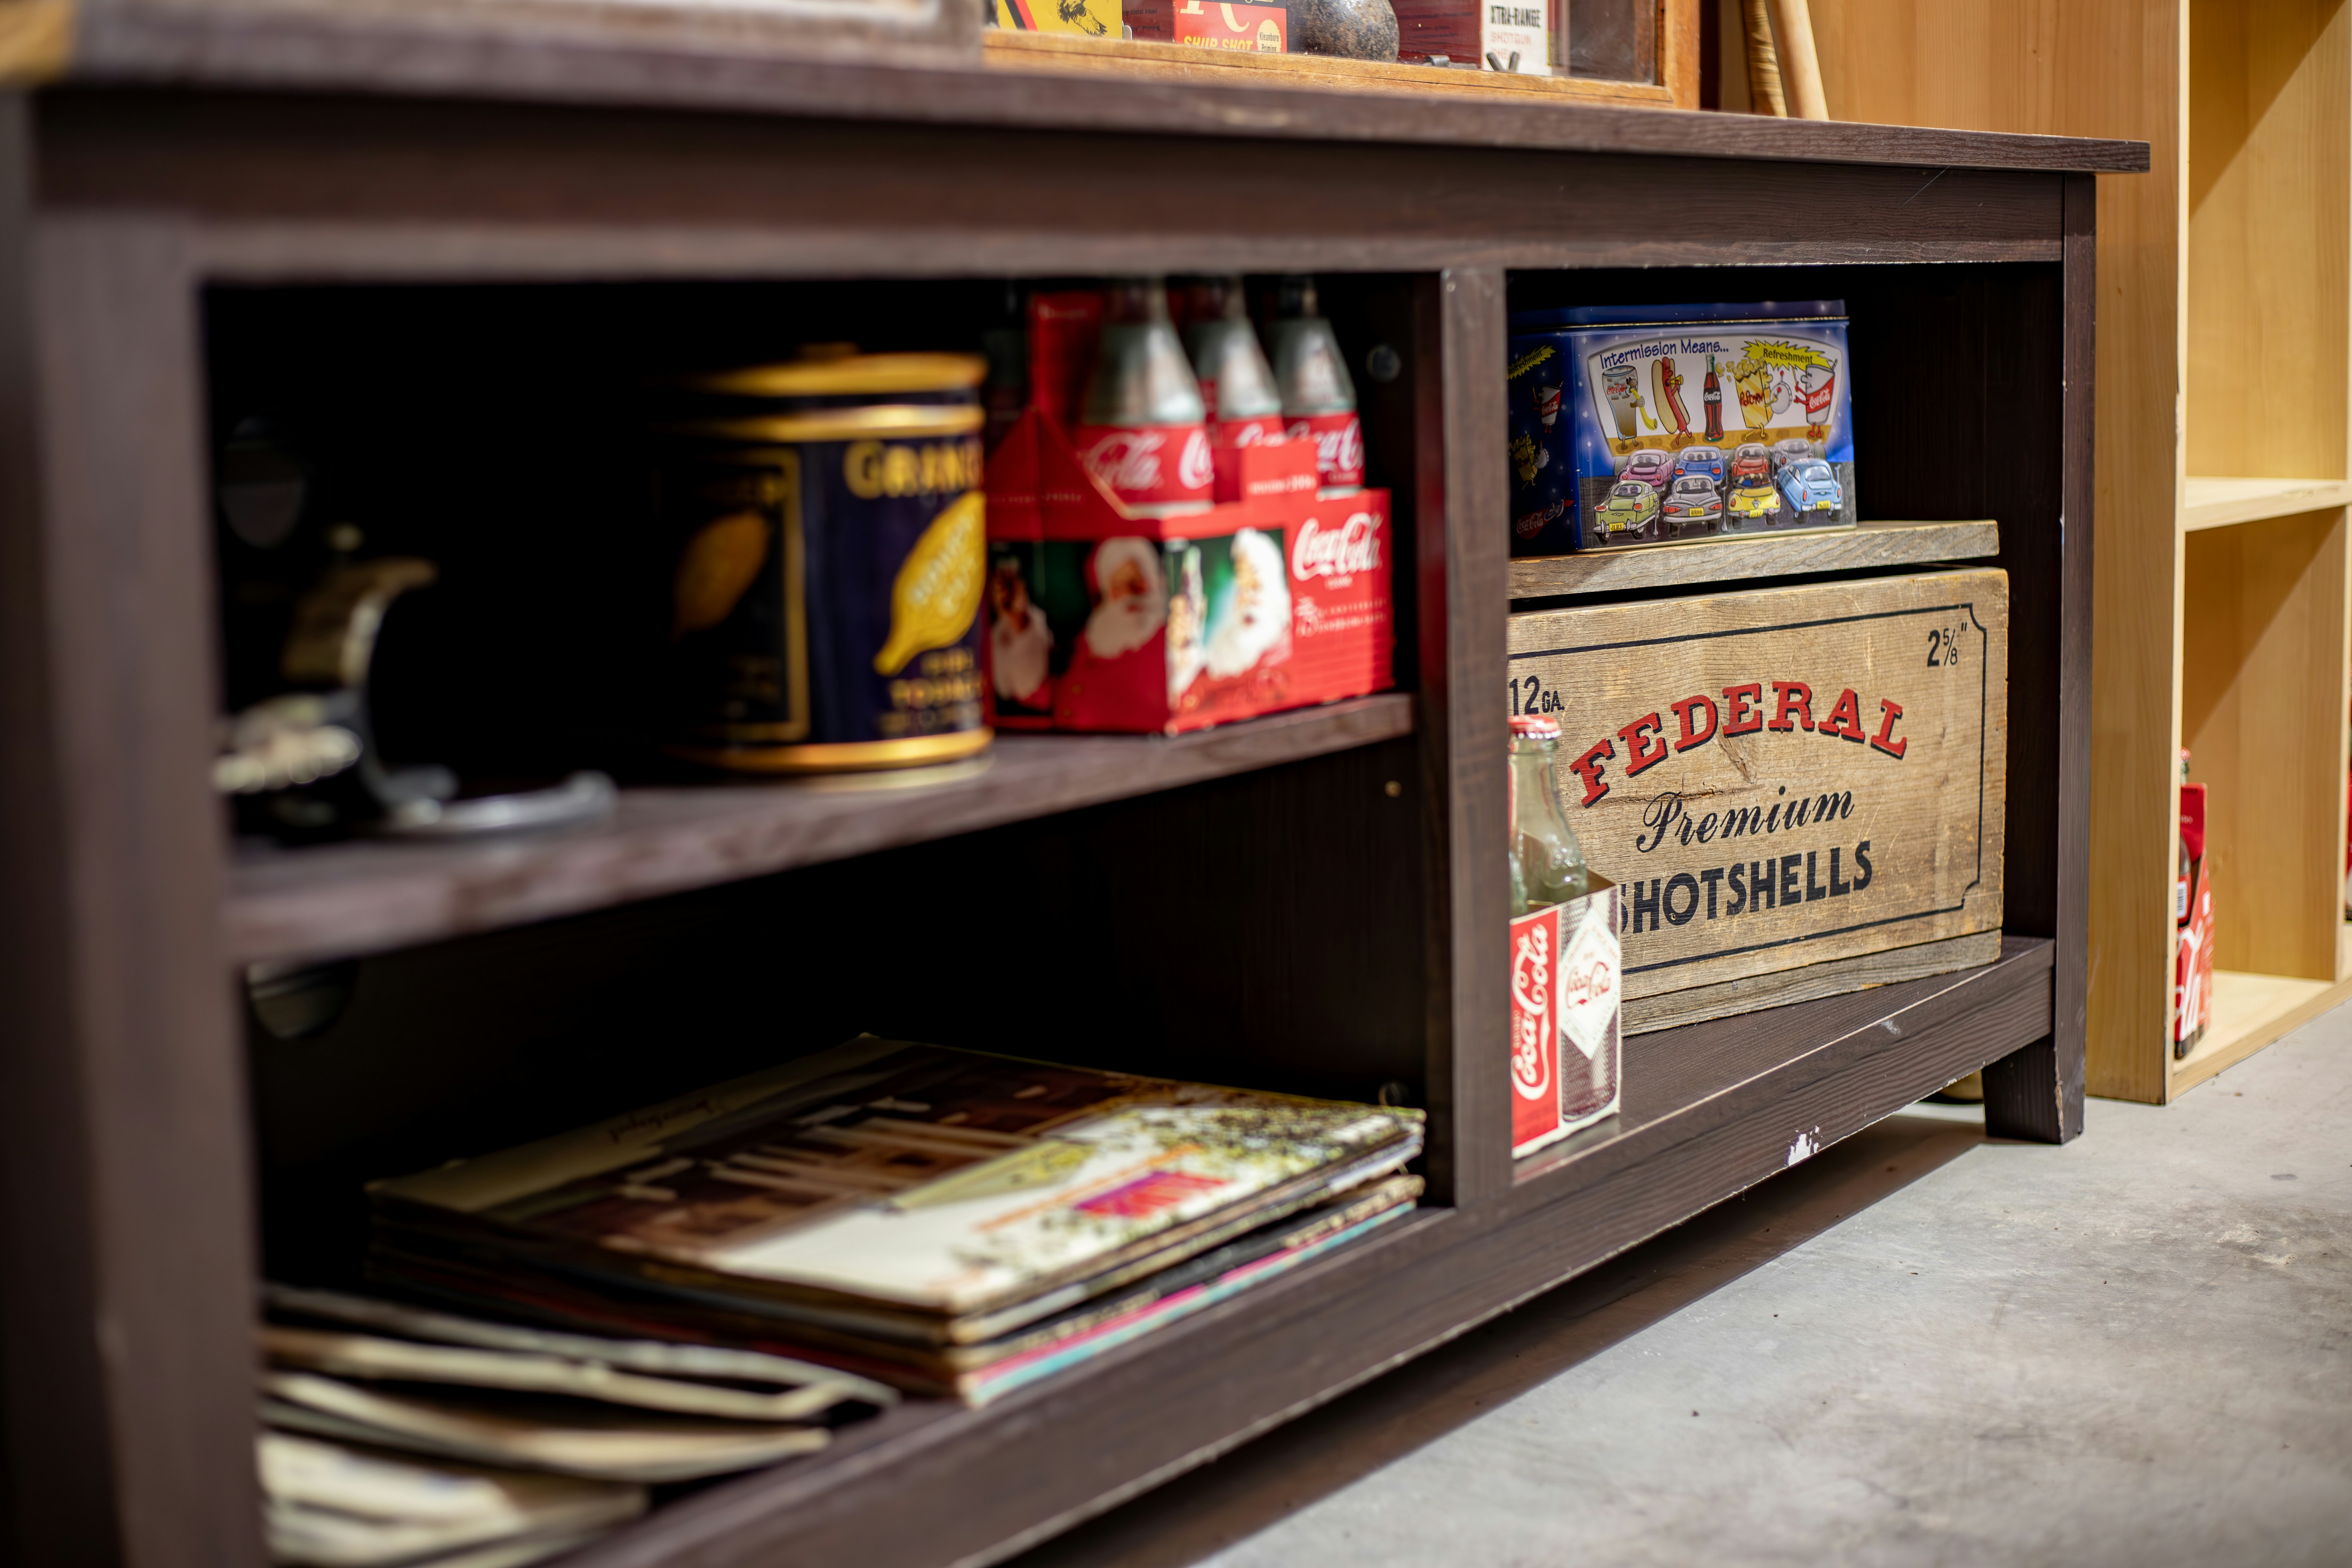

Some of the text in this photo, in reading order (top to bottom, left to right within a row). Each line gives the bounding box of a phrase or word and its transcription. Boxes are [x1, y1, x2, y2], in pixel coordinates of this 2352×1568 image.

[1491, 5, 1540, 28] XTRA-RANGE
[1259, 32, 1279, 42] Kleanbore
[1490, 31, 1531, 46] SHOTGUN
[1600, 339, 1729, 369] Intermission Means...
[1763, 348, 1813, 364] Refreshment
[1292, 511, 1384, 581] Coca-Cola
[1570, 681, 1908, 808] FEDERAL
[1636, 786, 1855, 853] Premium
[1565, 961, 1610, 1009] Coca-Cola
[1511, 923, 1550, 1100] Coca-Cola
